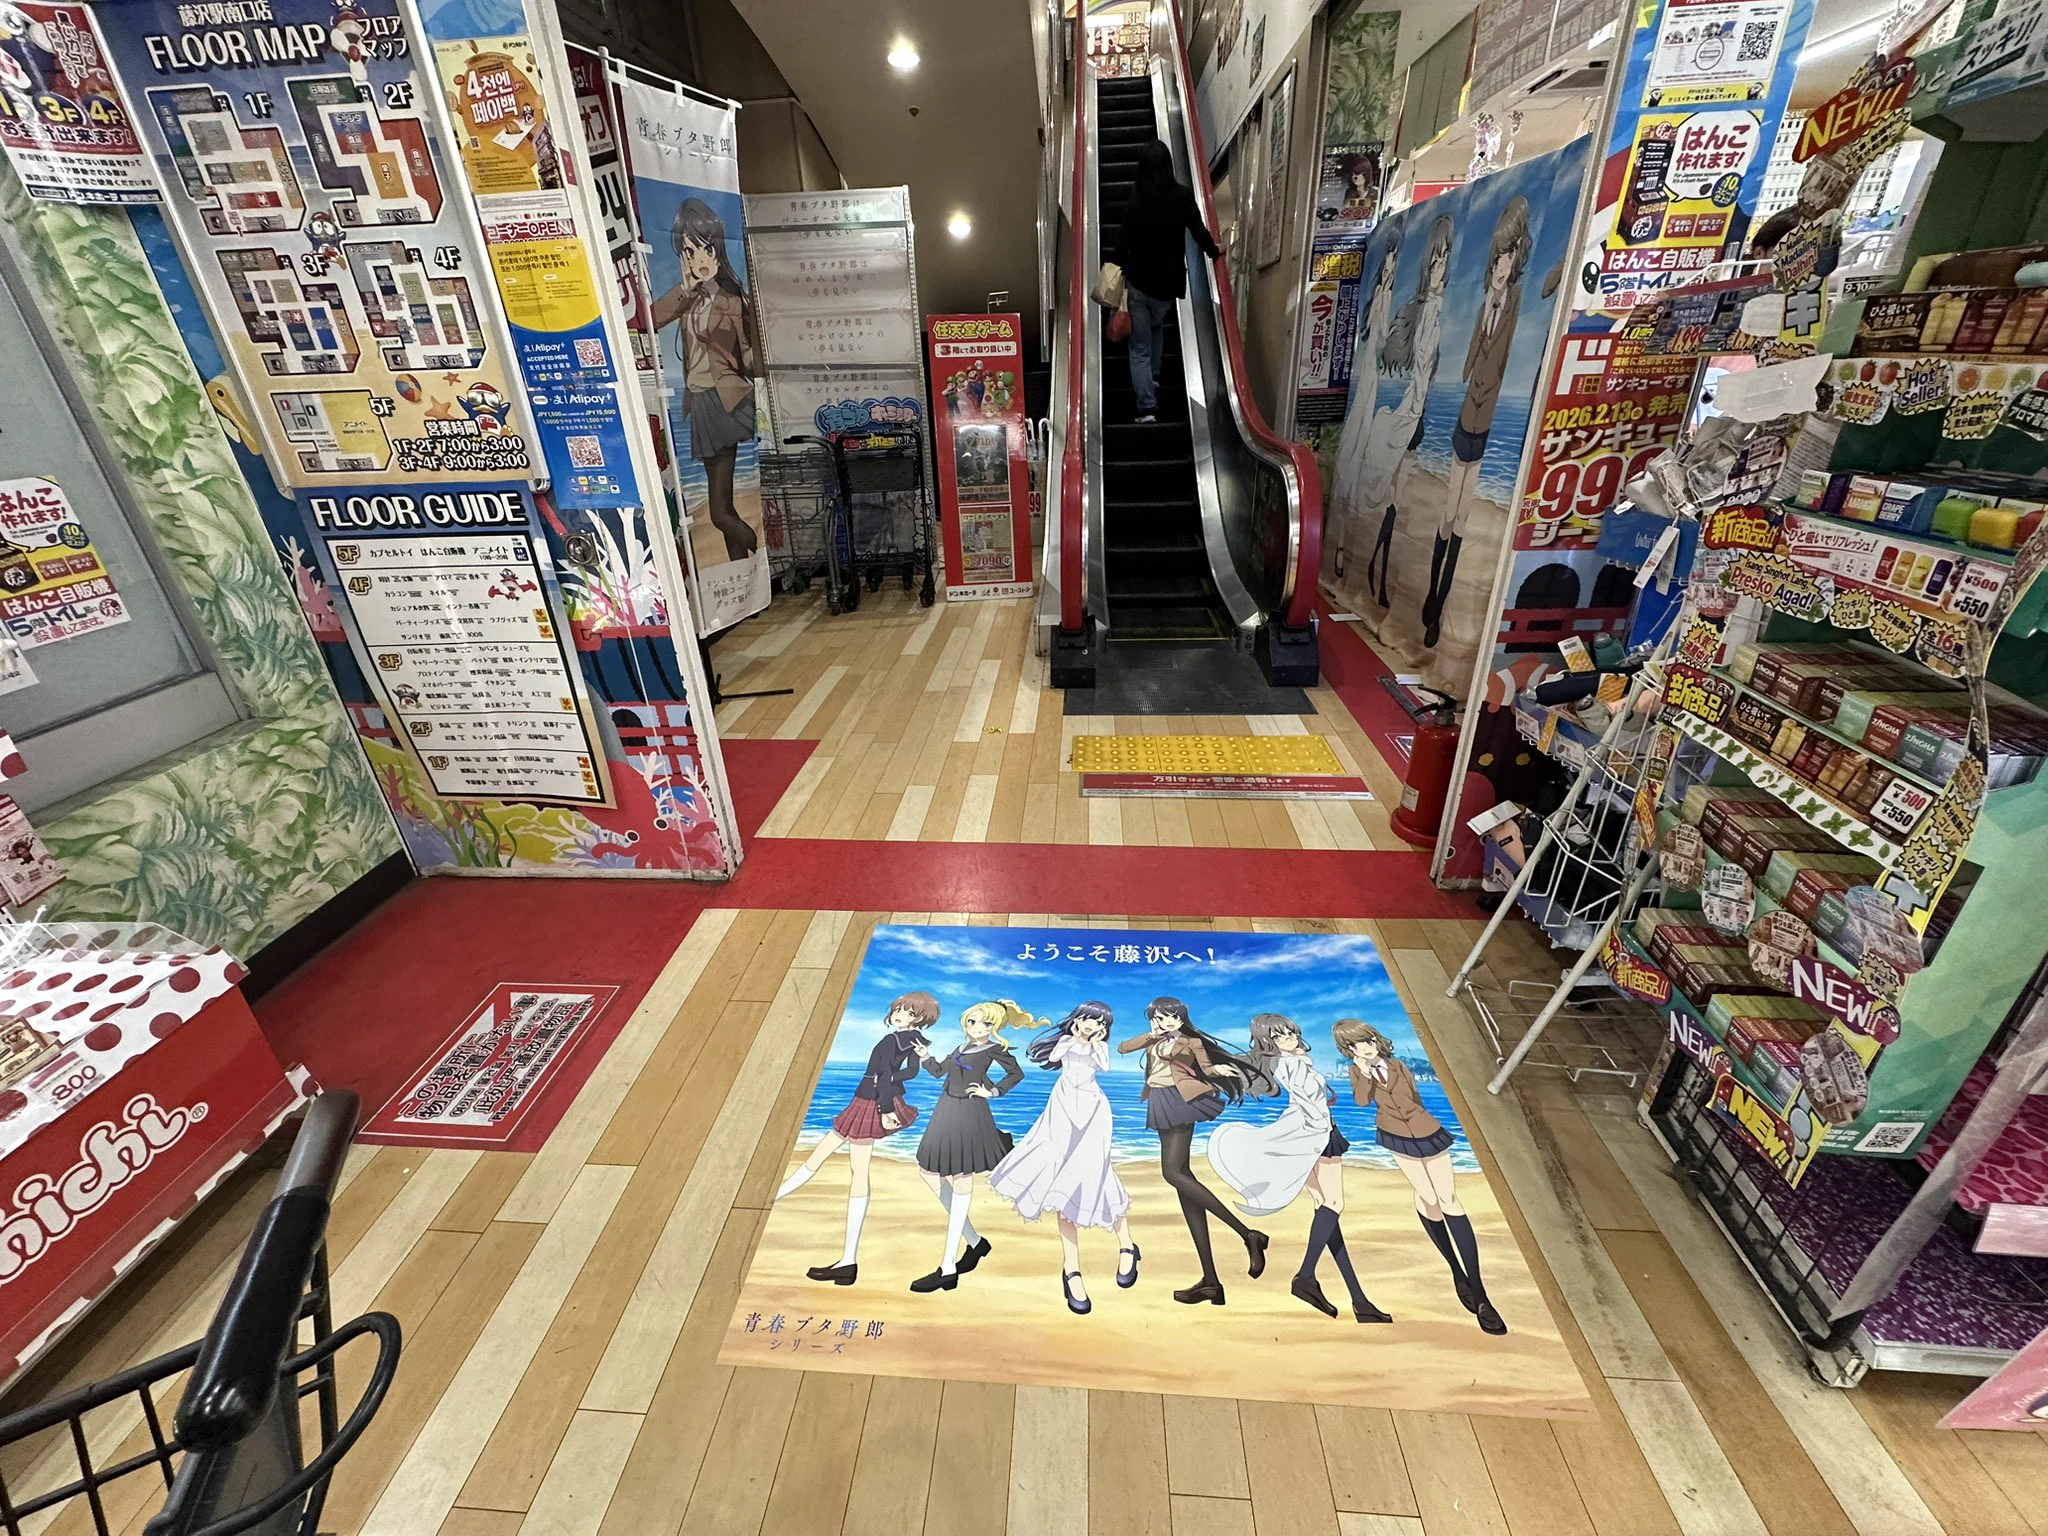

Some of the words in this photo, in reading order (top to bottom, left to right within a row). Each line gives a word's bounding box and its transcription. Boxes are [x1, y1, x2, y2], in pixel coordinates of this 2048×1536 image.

[177, 1, 273, 27] 藤沢駅南口店
[1127, 11, 1141, 24] 3F
[357, 16, 401, 37] フロア
[144, 30, 253, 69] FLOOR
[253, 24, 326, 61] MAP
[244, 92, 272, 117] 1F
[384, 83, 411, 106] 2F
[1799, 82, 1905, 161] NEW!!
[635, 115, 732, 154] 青春ブタ野郎
[1681, 124, 1751, 152] はんこ
[664, 148, 713, 164] シリーズ
[1676, 151, 1745, 171] 作れます!
[303, 253, 328, 275] 3F
[434, 247, 459, 269] 4F
[1608, 248, 1717, 271] はんこ自販機
[1780, 236, 1818, 268] Madaling
[1323, 252, 1362, 279] 増税
[1783, 250, 1818, 283] Dalhin!
[933, 320, 1014, 340] 任天堂ゲーム
[1556, 338, 1613, 396] ド
[1908, 368, 1934, 390] Hot
[371, 398, 394, 416] 5F
[1648, 393, 1690, 417] 発売
[1900, 384, 1946, 408] Seller!
[427, 421, 478, 437] 営業時間
[439, 436, 523, 451] 7:00から3:00
[444, 453, 527, 469] 9:00から3:00
[1, 506, 67, 530] 作れます!
[309, 496, 420, 528] FLOOR
[424, 493, 526, 524] GUIDE
[1882, 501, 1905, 514] GRAPE
[1711, 510, 1780, 549] 新商品!!
[336, 545, 360, 564] 5F
[1745, 559, 1763, 572] Isang
[1765, 564, 1791, 581] Singhot
[348, 575, 372, 595] 4F
[1730, 566, 1773, 596] Presko
[1772, 583, 1817, 612] Agad!
[4, 578, 112, 618] はんこ自販機
[1953, 596, 1990, 619] ¥550
[378, 654, 401, 671] 3F
[1667, 672, 1728, 724] 新商品!
[411, 721, 432, 736] 2F
[428, 755, 449, 770] 1F
[1881, 805, 1914, 828] ¥550
[1016, 942, 1218, 966] ようこそ藤沢へ!
[1792, 959, 1877, 1036] NEW!!
[418, 995, 539, 1120] 物品を置かない事
[490, 1088, 523, 1122] Please
[518, 1076, 534, 1091] do
[526, 1061, 545, 1080] not
[547, 1016, 581, 1050] anything
[399, 1033, 486, 1118] この場所に
[1728, 1085, 1792, 1170] NEW!!
[744, 1312, 886, 1341] 青春ブタ野郎
[769, 1339, 846, 1354] シリーズ
